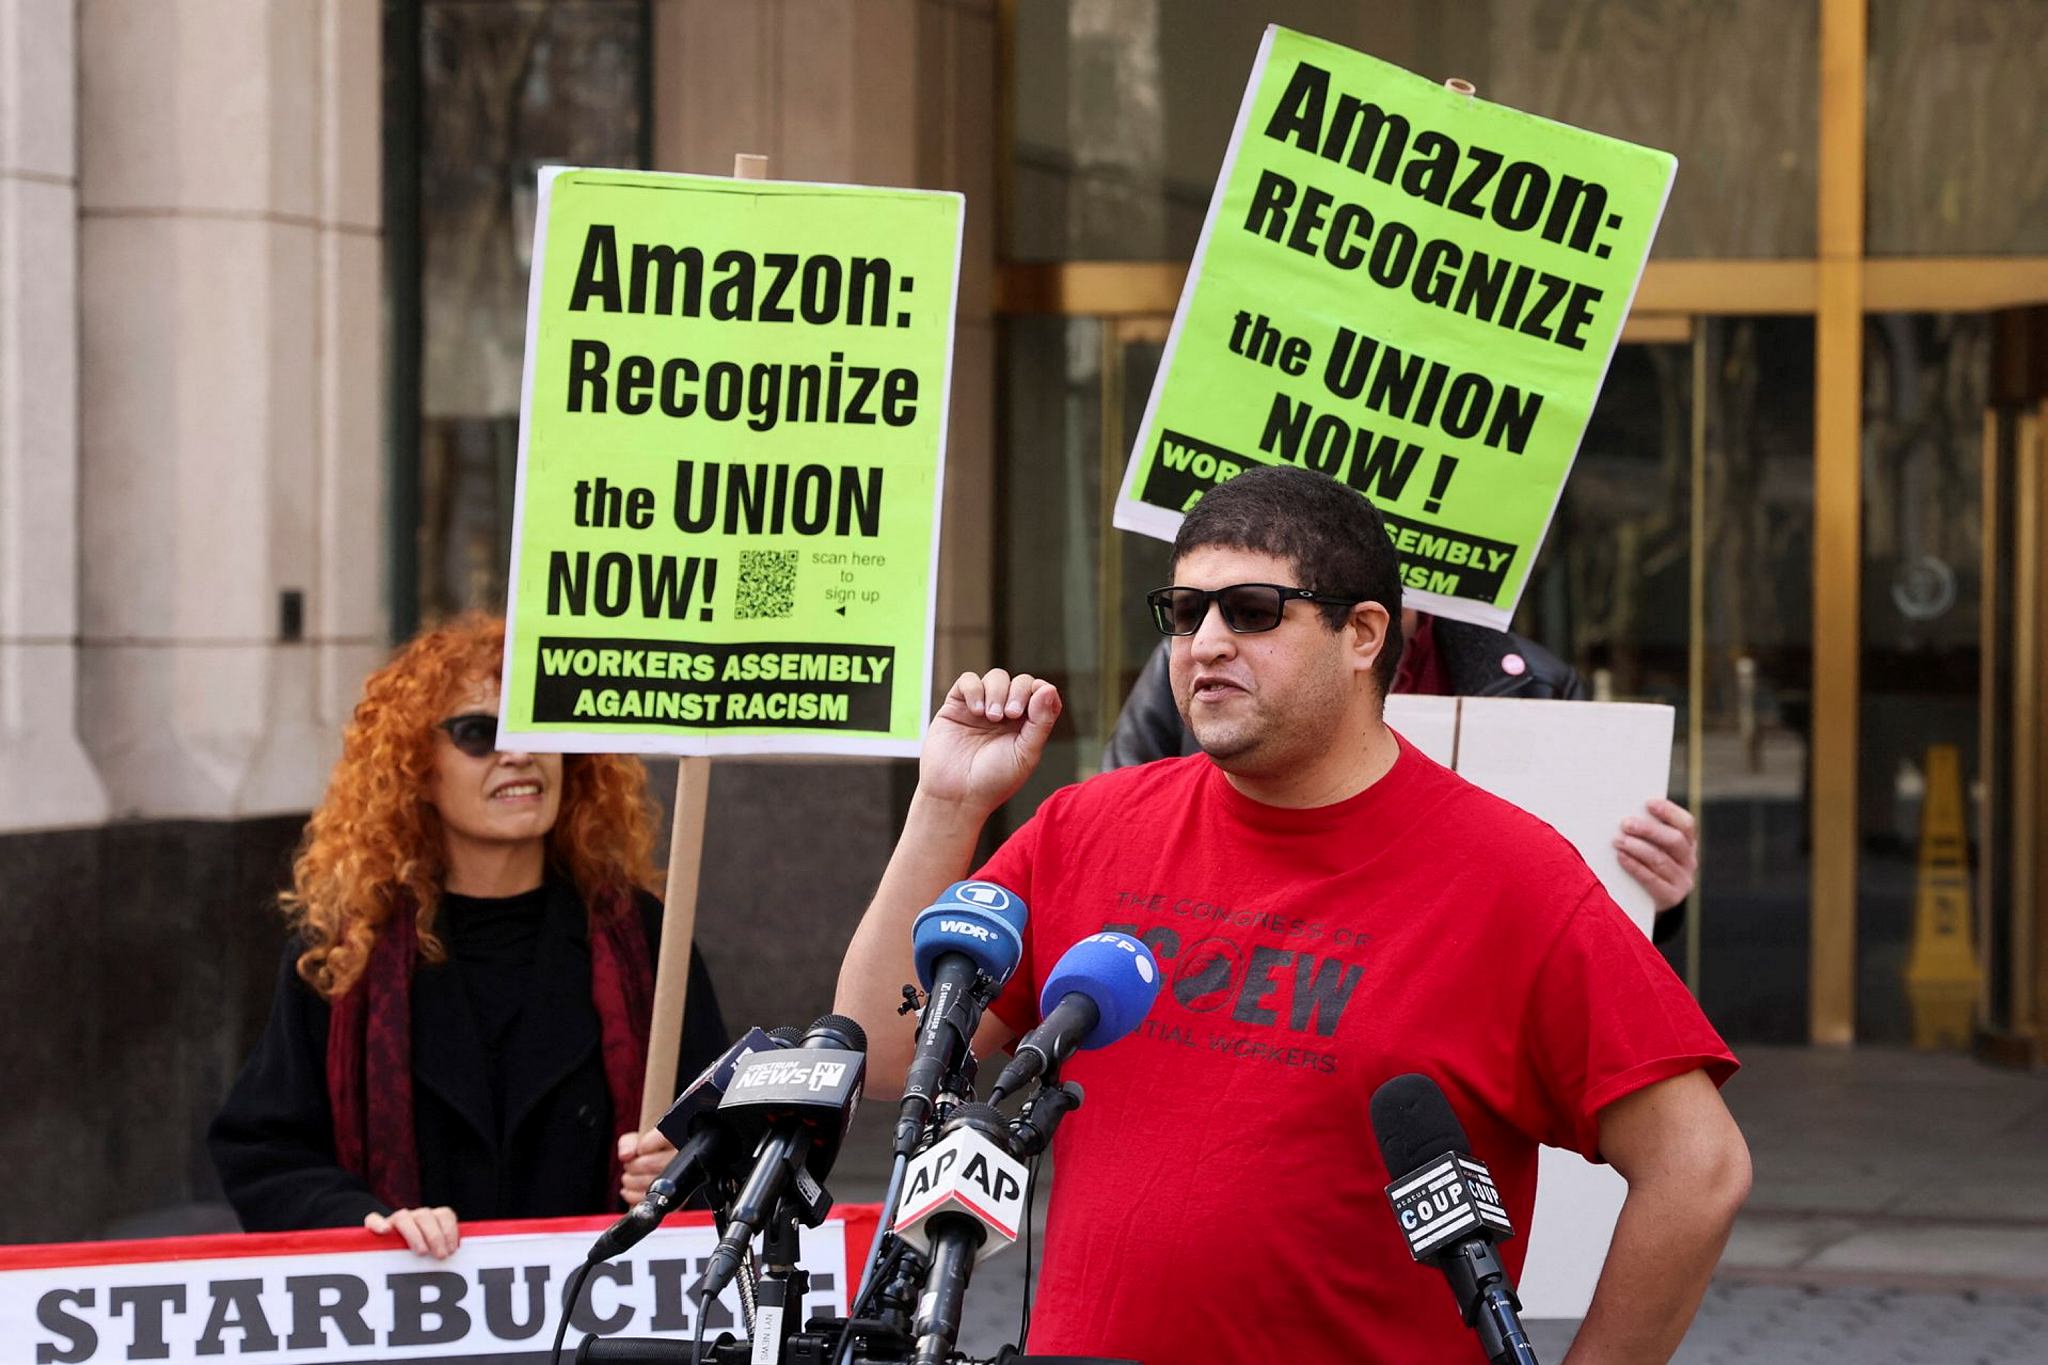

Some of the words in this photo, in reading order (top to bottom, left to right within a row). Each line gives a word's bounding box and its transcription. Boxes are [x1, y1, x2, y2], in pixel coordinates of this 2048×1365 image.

[1264, 61, 1623, 260] Amazon:
[568, 224, 914, 328] Amazon:
[1243, 169, 1603, 351] RECOGNIZE
[567, 339, 919, 431] Recognize
[1228, 310, 1312, 377] the
[1323, 327, 1544, 455] UNION
[1259, 391, 1425, 502] NOW
[1423, 454, 1459, 515] !
[574, 477, 655, 529] the
[673, 460, 883, 537] UNION
[812, 552, 847, 566] scan
[851, 552, 886, 566] here
[1384, 522, 1510, 573] SEMBLY
[546, 551, 717, 622] NOW!
[825, 586, 860, 604] sign
[864, 589, 880, 604] up
[840, 569, 854, 583] to
[542, 648, 714, 682] WORKERS
[721, 650, 889, 684] ASSEMBLY
[573, 690, 721, 721] AGAINST
[726, 694, 848, 721] RACISM
[1116, 892, 1167, 911] THE
[1173, 899, 1325, 940] CONGRESS
[1334, 928, 1374, 948] OF
[736, 1066, 811, 1089] NEWS
[747, 1061, 800, 1072] SPECTRUM
[1209, 1035, 1338, 1073] WORKERS
[904, 1148, 958, 1207] AP
[961, 1152, 1020, 1203] AP
[1467, 1179, 1499, 1205] COUP
[1401, 1182, 1463, 1230] COUP
[37, 1254, 834, 1365] STARBUCK:
